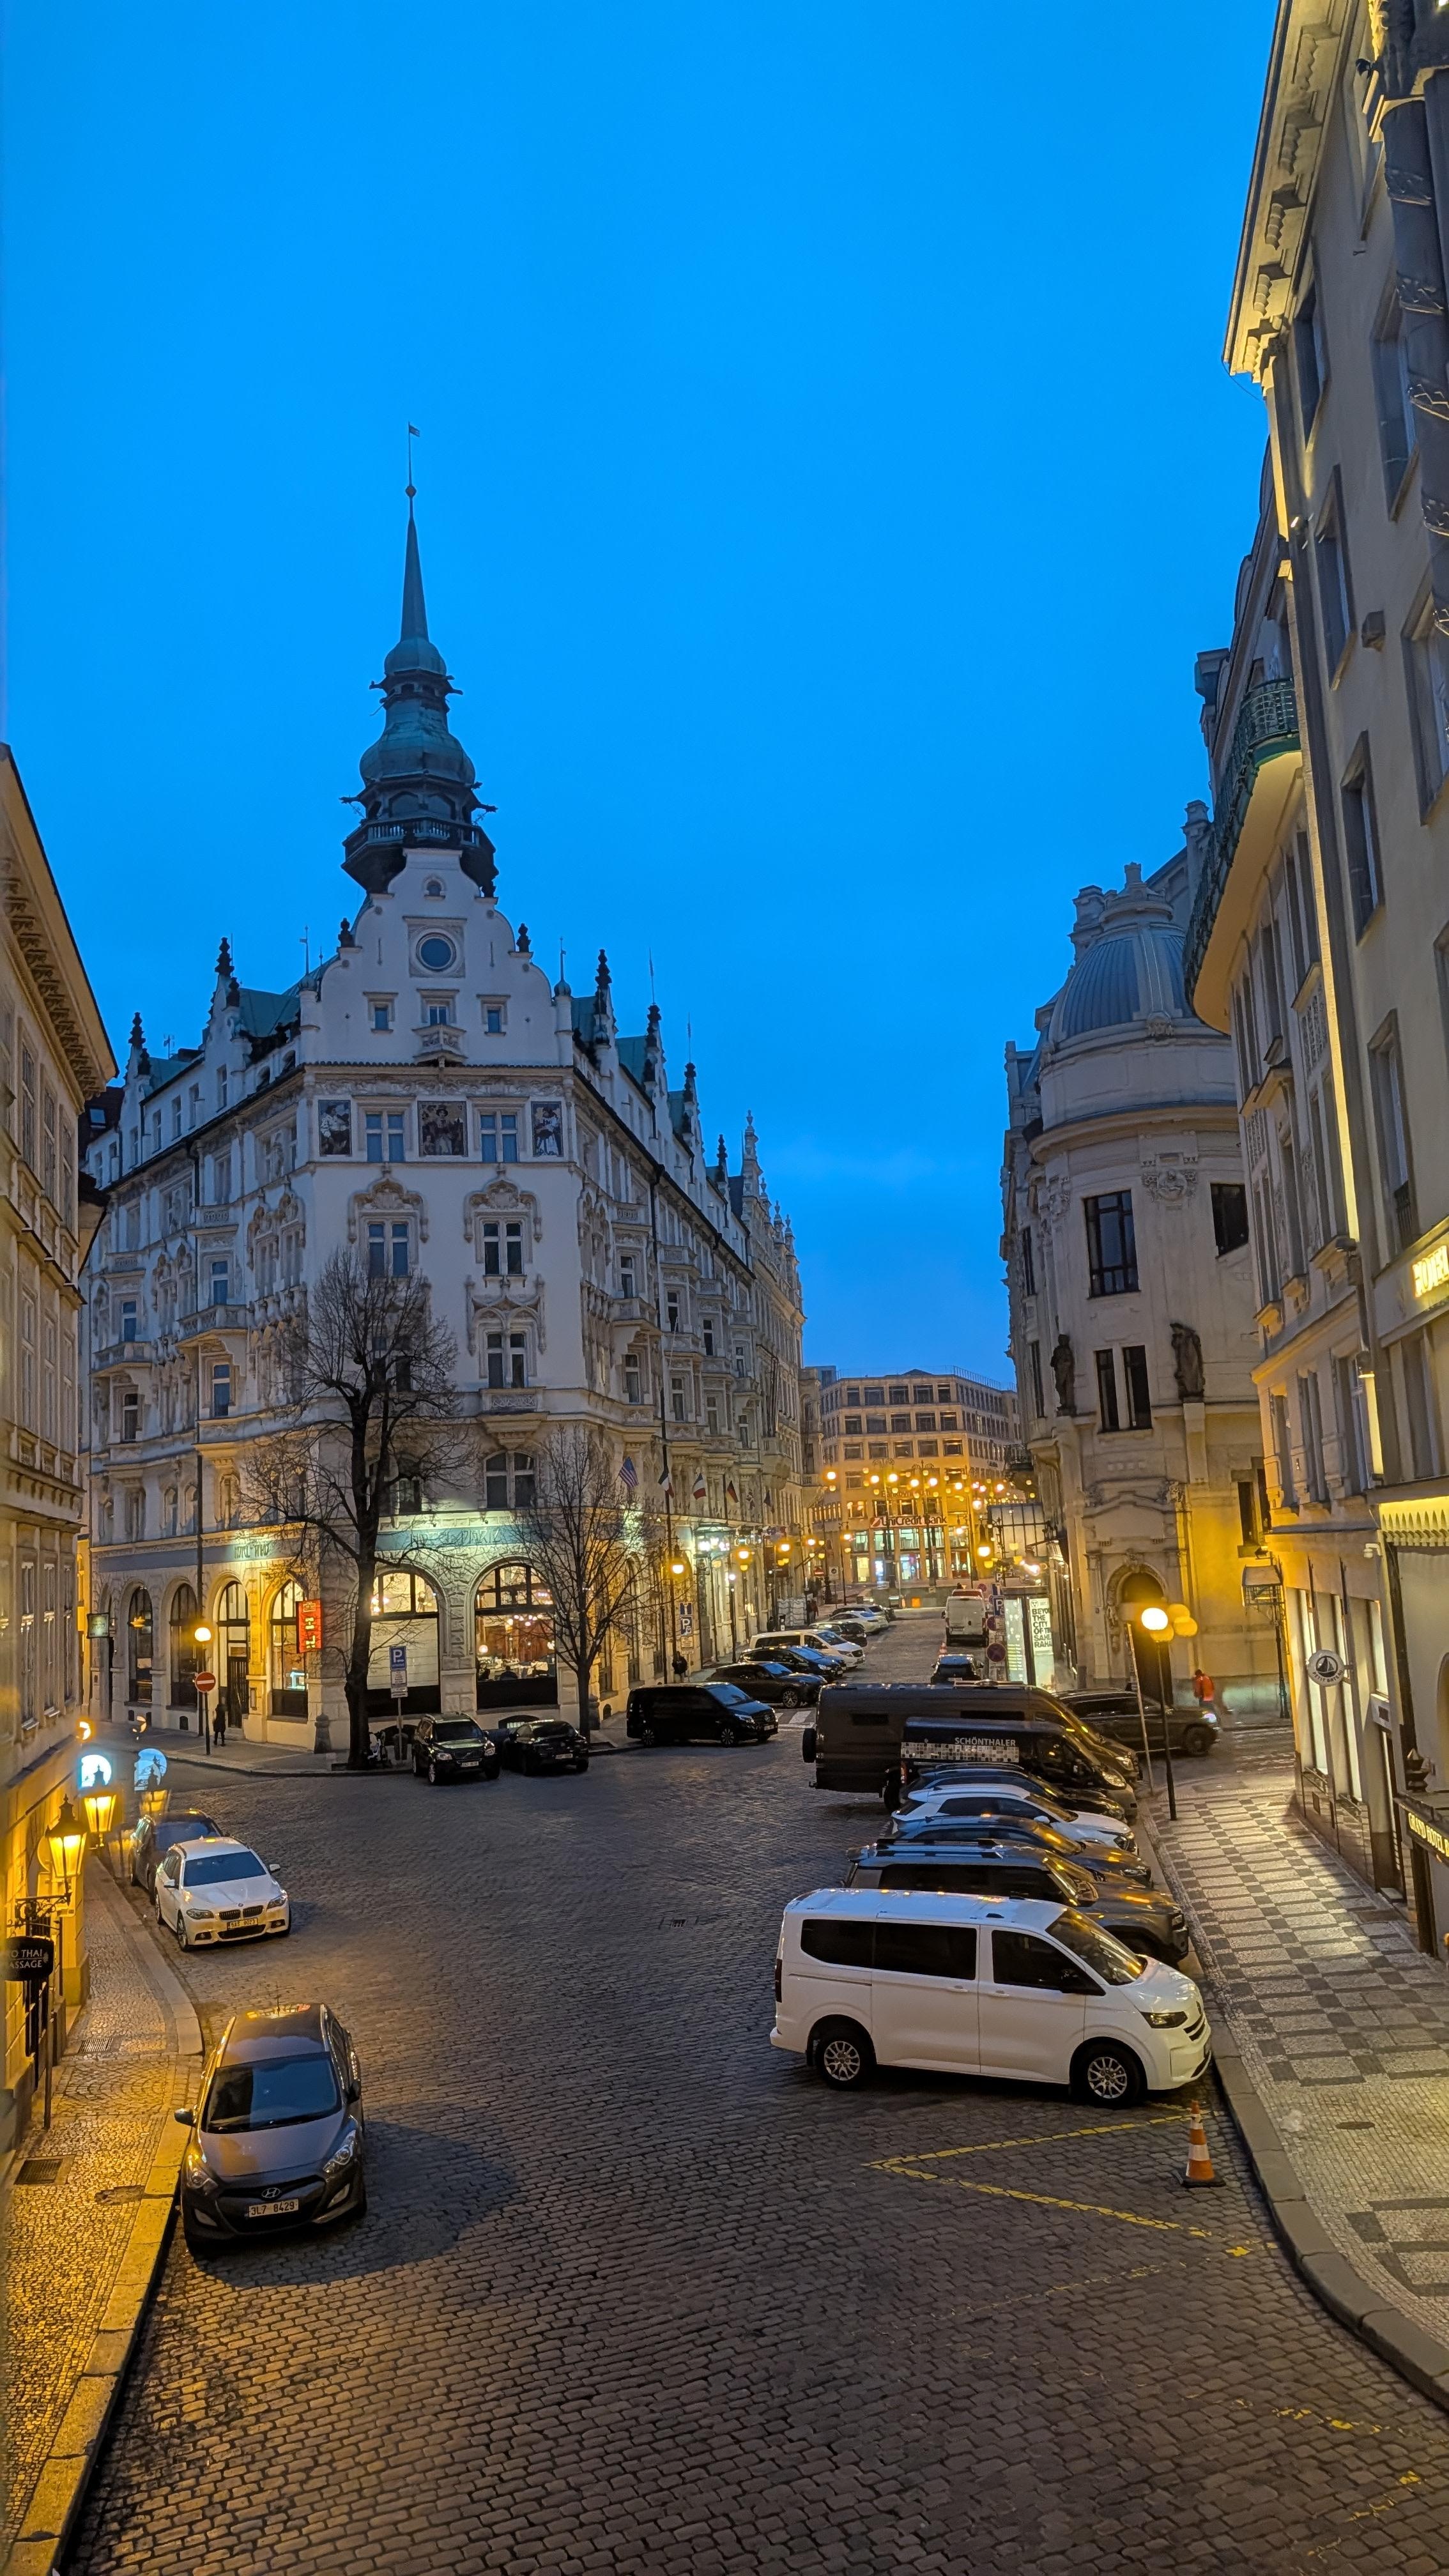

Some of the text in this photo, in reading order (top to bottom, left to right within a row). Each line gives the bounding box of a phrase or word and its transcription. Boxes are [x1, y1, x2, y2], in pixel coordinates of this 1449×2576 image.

[882, 1515, 947, 1526] UniCredit Bank
[996, 1599, 1003, 1611] P
[682, 1618, 690, 1630] P
[393, 1649, 402, 1663] P
[1312, 1671, 1325, 1682] PETIT
[954, 1736, 1016, 1747] SCHÖNTHALER
[1408, 1812, 1427, 1839] GRAND
[1425, 1825, 1445, 1854] HOTEL
[21, 1949, 43, 1958] THAI
[9, 1959, 43, 1968] ASSAGE
[250, 2201, 295, 2216] 3L7 8429
